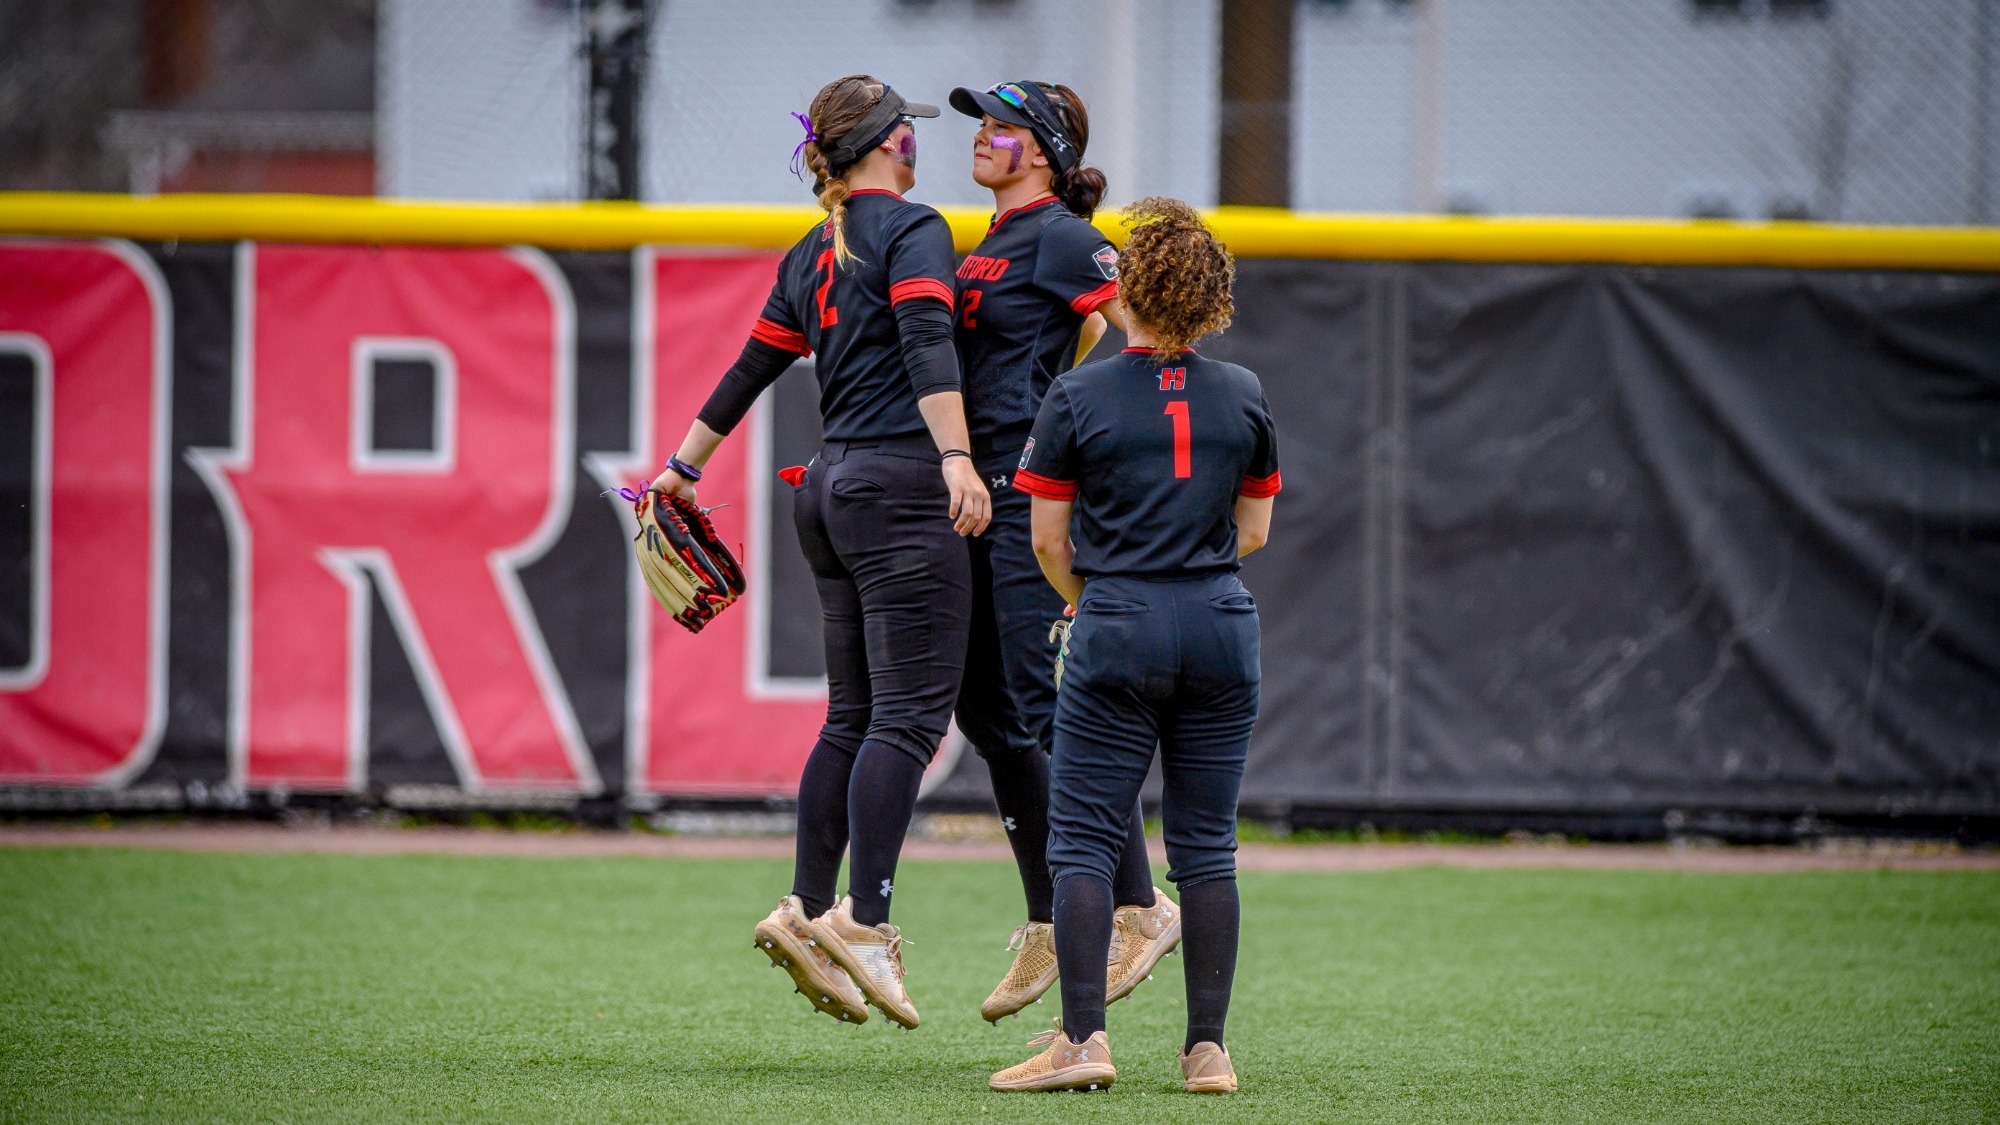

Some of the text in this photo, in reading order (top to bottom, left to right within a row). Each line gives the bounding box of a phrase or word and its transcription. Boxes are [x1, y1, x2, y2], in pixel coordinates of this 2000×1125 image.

[815, 247, 839, 329] 2
[1159, 367, 1187, 391] H
[1163, 400, 1191, 479] 1
